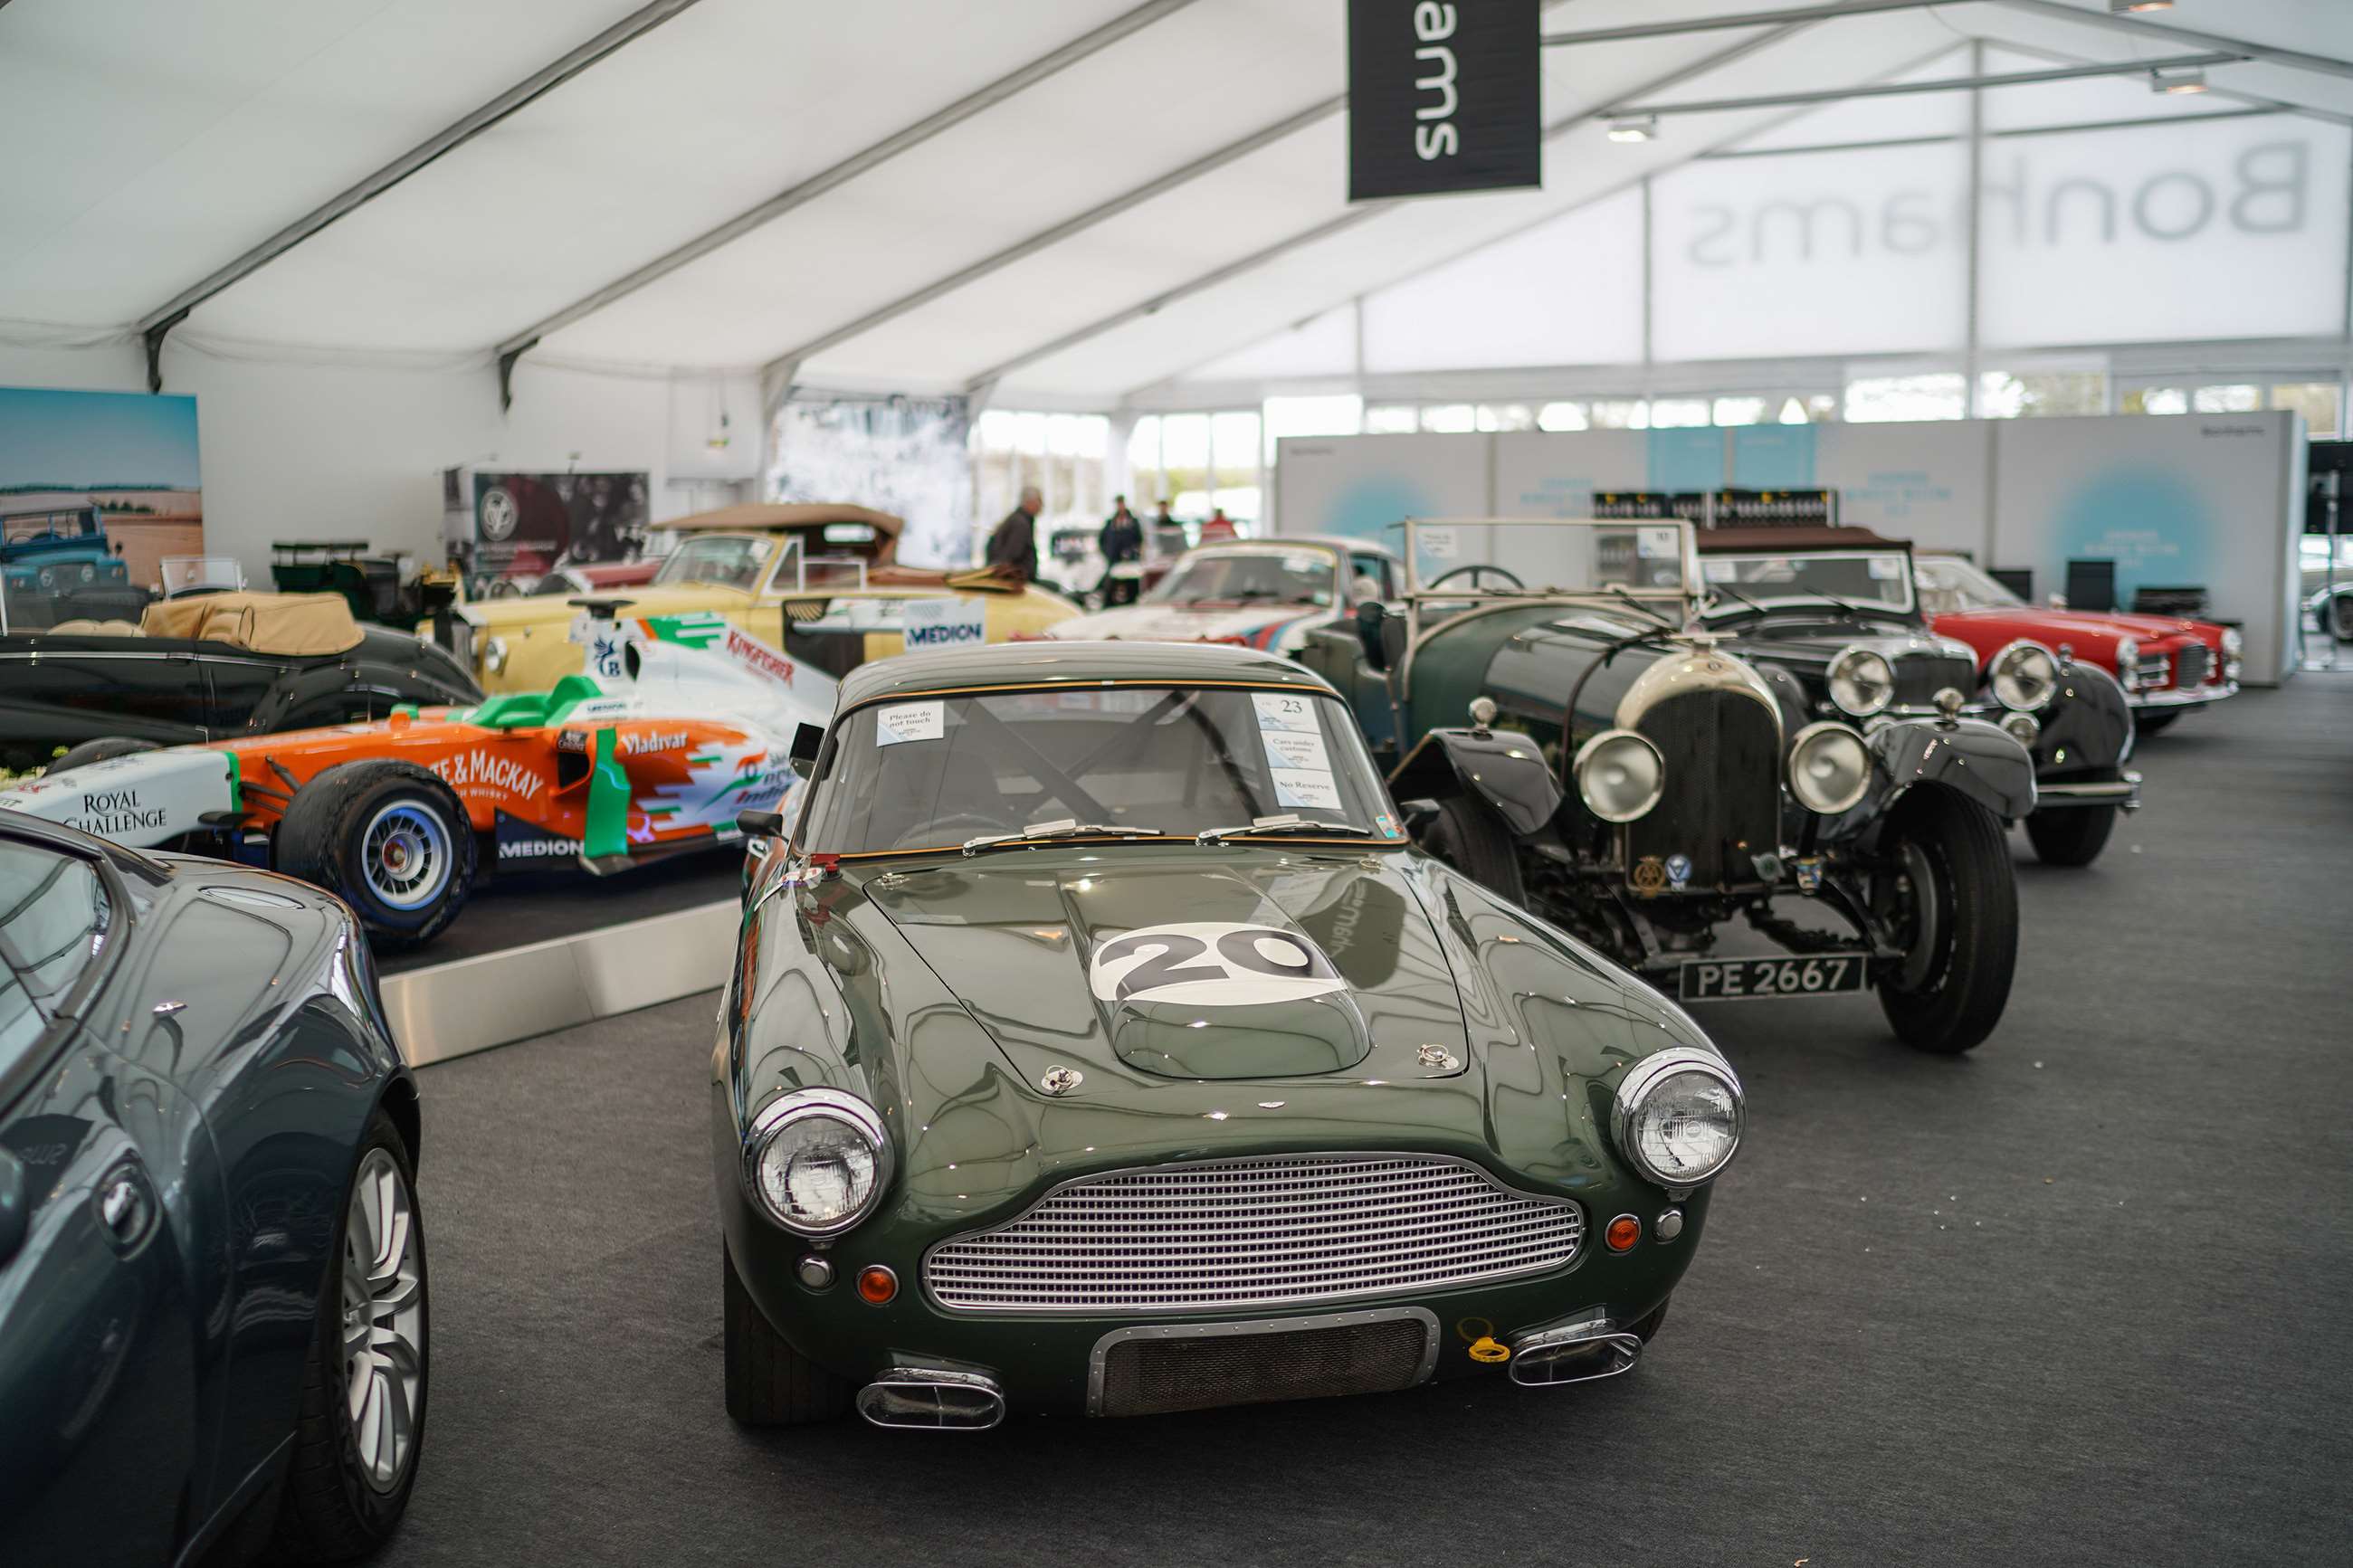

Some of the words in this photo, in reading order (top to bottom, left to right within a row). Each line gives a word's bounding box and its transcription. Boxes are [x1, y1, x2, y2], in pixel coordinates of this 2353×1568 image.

[907, 623, 982, 646] MEDION
[1281, 699, 1302, 714] 23
[453, 754, 468, 784] &
[470, 748, 545, 800] MACKAY
[84, 789, 141, 816] ROYAL
[499, 840, 585, 859] MEDION
[1099, 930, 1341, 1001] 20
[1698, 963, 1744, 995] PE
[1753, 959, 1849, 994] 2667
